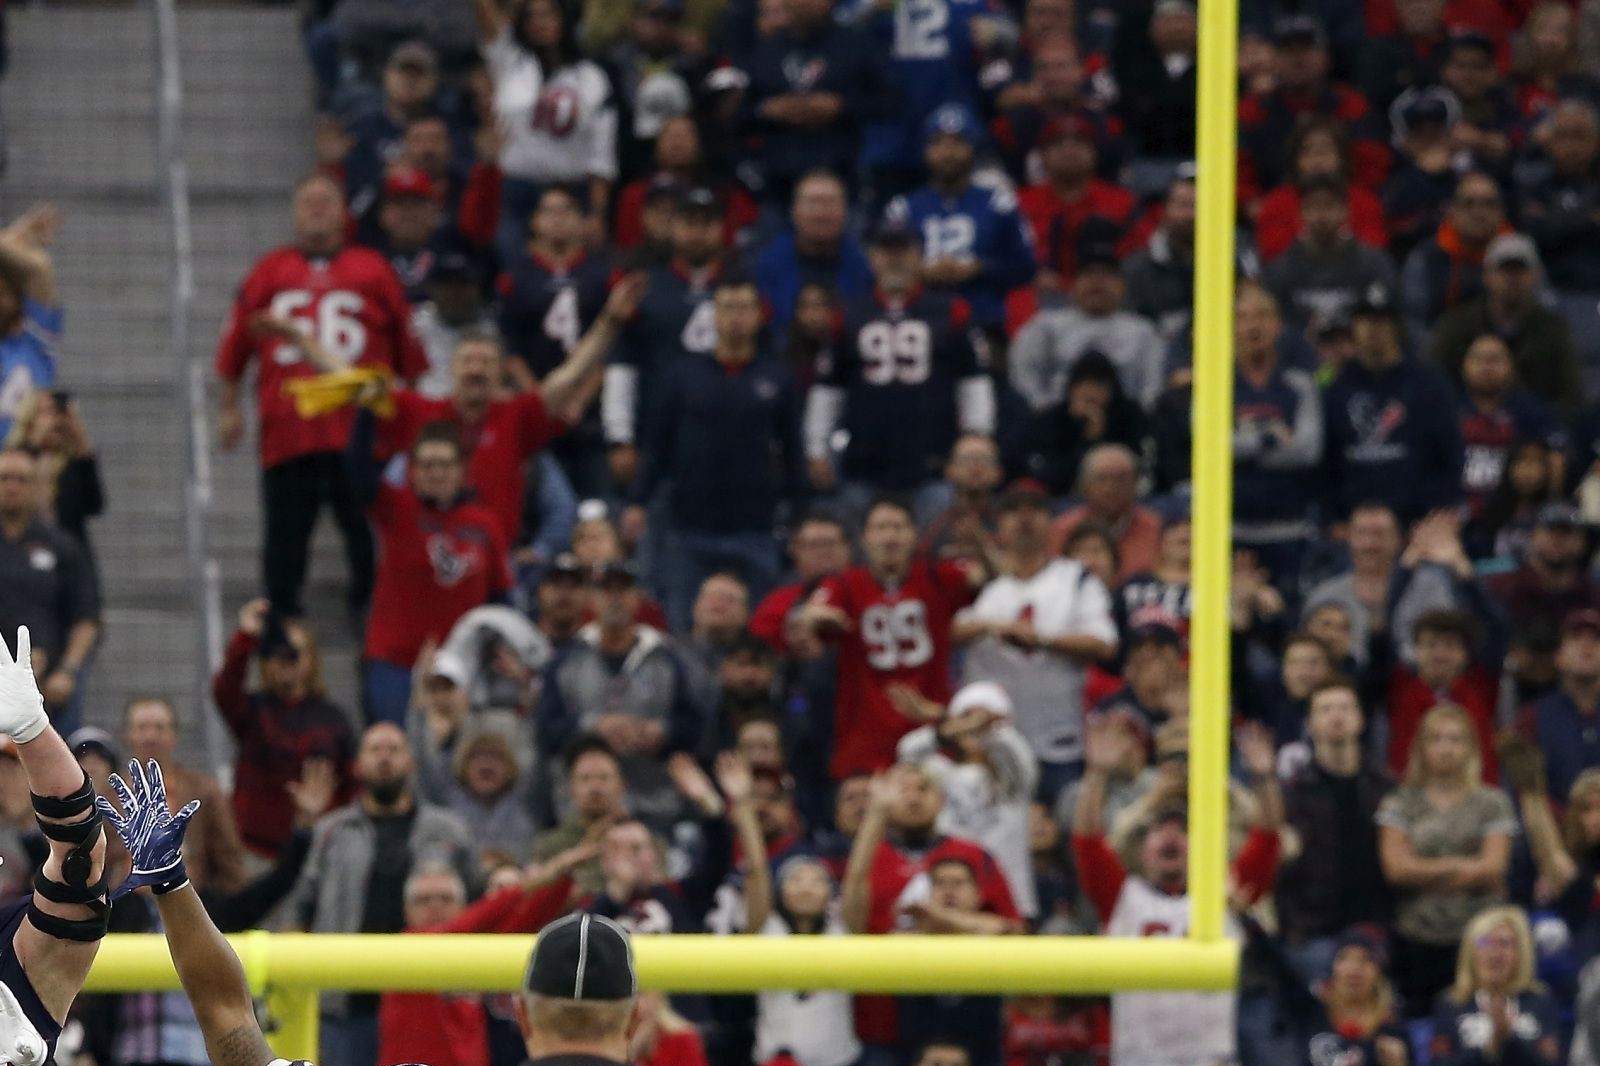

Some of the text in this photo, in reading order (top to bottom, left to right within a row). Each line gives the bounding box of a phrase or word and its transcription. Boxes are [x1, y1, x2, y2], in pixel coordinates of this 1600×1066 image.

[921, 214, 977, 268] 12
[858, 319, 932, 386] 99
[861, 598, 934, 670] 99
